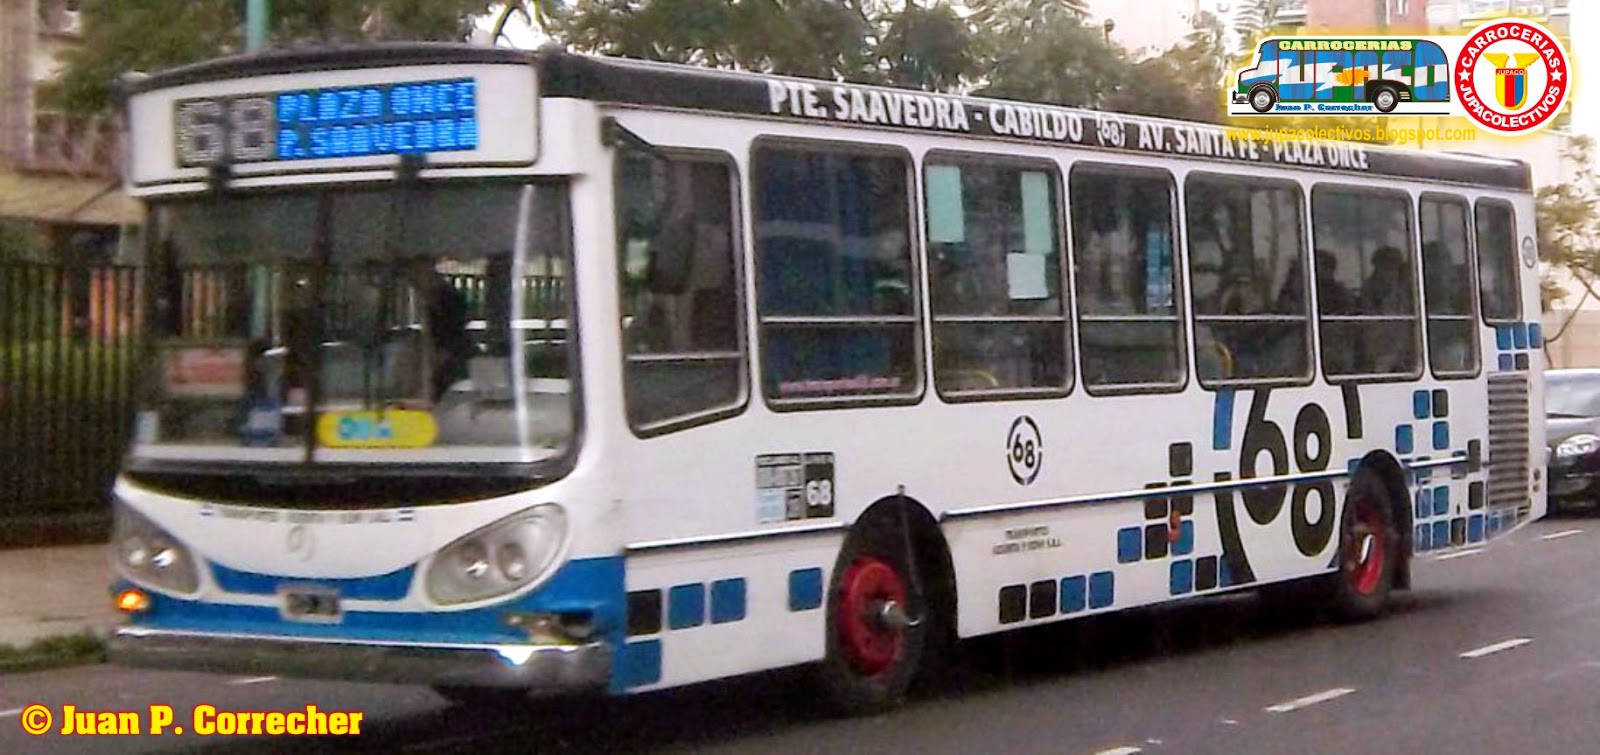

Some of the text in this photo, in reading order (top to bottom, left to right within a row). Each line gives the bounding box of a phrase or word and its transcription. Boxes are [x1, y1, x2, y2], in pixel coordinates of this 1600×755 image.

[278, 80, 477, 123] PLAZA ONCE
[768, 79, 827, 119] PTE.
[835, 85, 969, 131] SAAVEDRA
[989, 101, 1083, 142] CABILDO
[1138, 123, 1172, 150] AV.
[1175, 128, 1235, 157] SANTA
[1238, 137, 1260, 161] FE
[1274, 139, 1323, 166] PLAZA
[1328, 144, 1369, 170] ONCE
[177, 98, 269, 164] 68
[1013, 433, 1036, 469] 68
[1240, 386, 1336, 558] 68
[806, 479, 832, 506] 68
